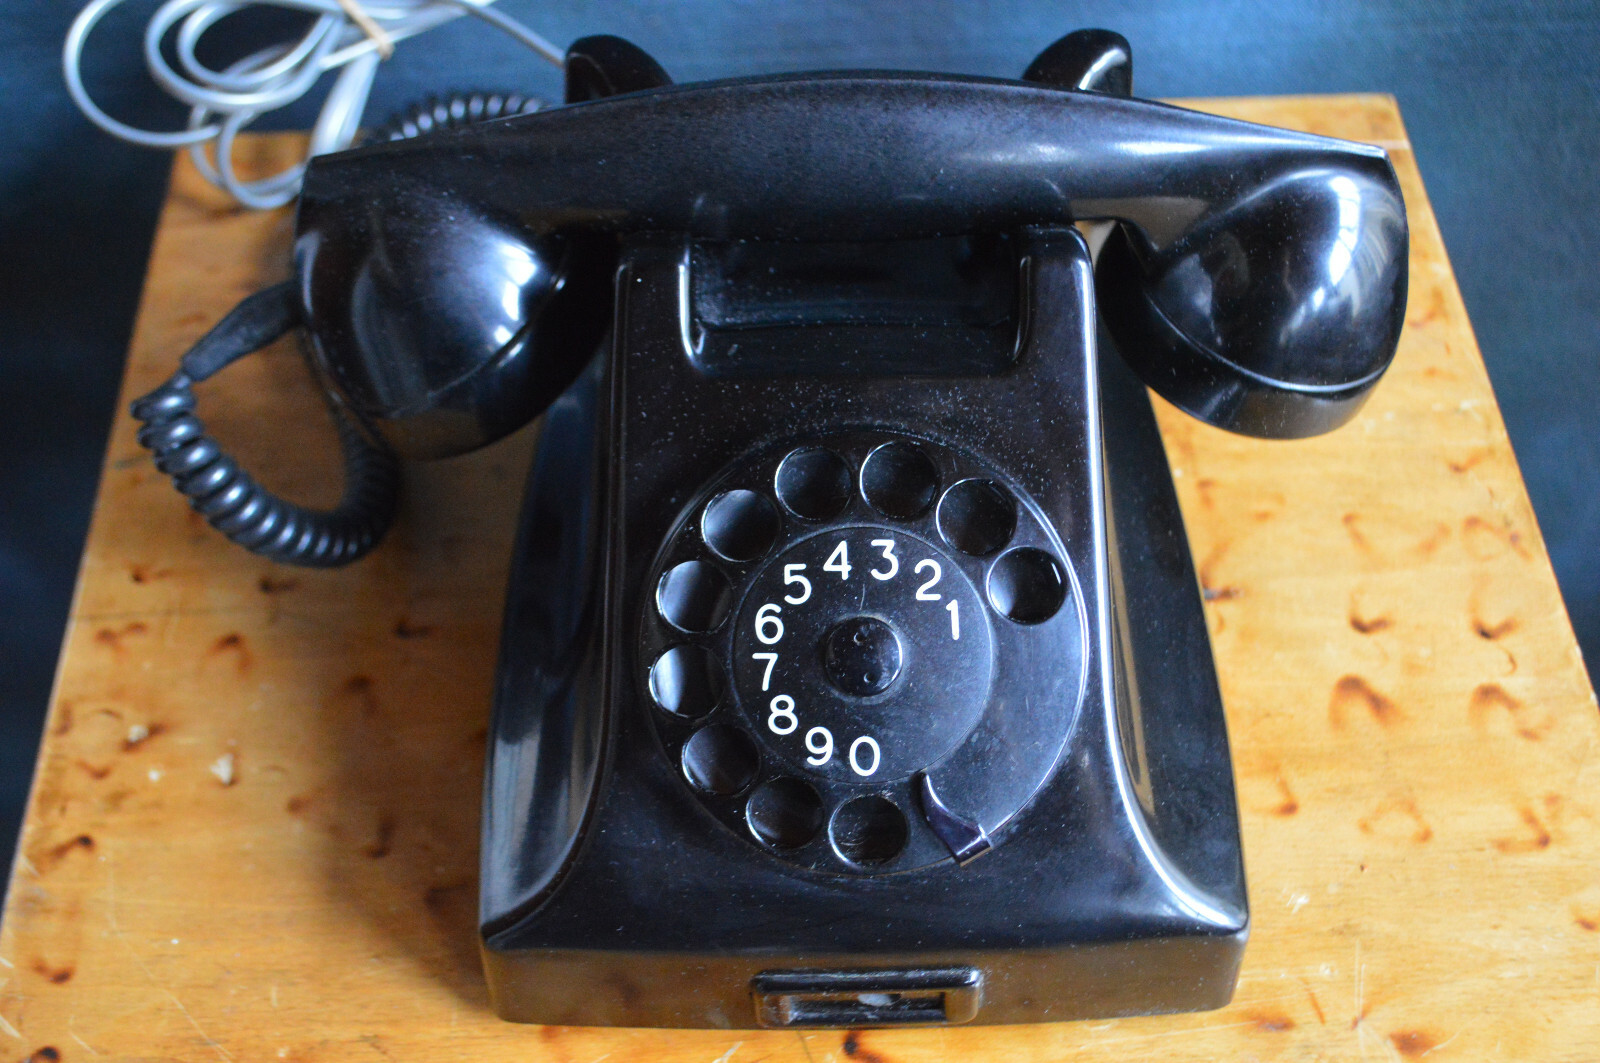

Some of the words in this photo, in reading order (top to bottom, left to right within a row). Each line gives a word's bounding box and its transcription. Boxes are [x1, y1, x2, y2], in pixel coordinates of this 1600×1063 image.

[823, 540, 851, 580] 4
[871, 539, 899, 580] 3
[914, 559, 941, 600] 2
[783, 563, 811, 604] 5
[755, 604, 784, 644] 6
[945, 599, 960, 640] 1
[752, 652, 778, 691] 7
[768, 695, 798, 735] 8
[805, 727, 833, 766] 9
[849, 736, 880, 776] 0
